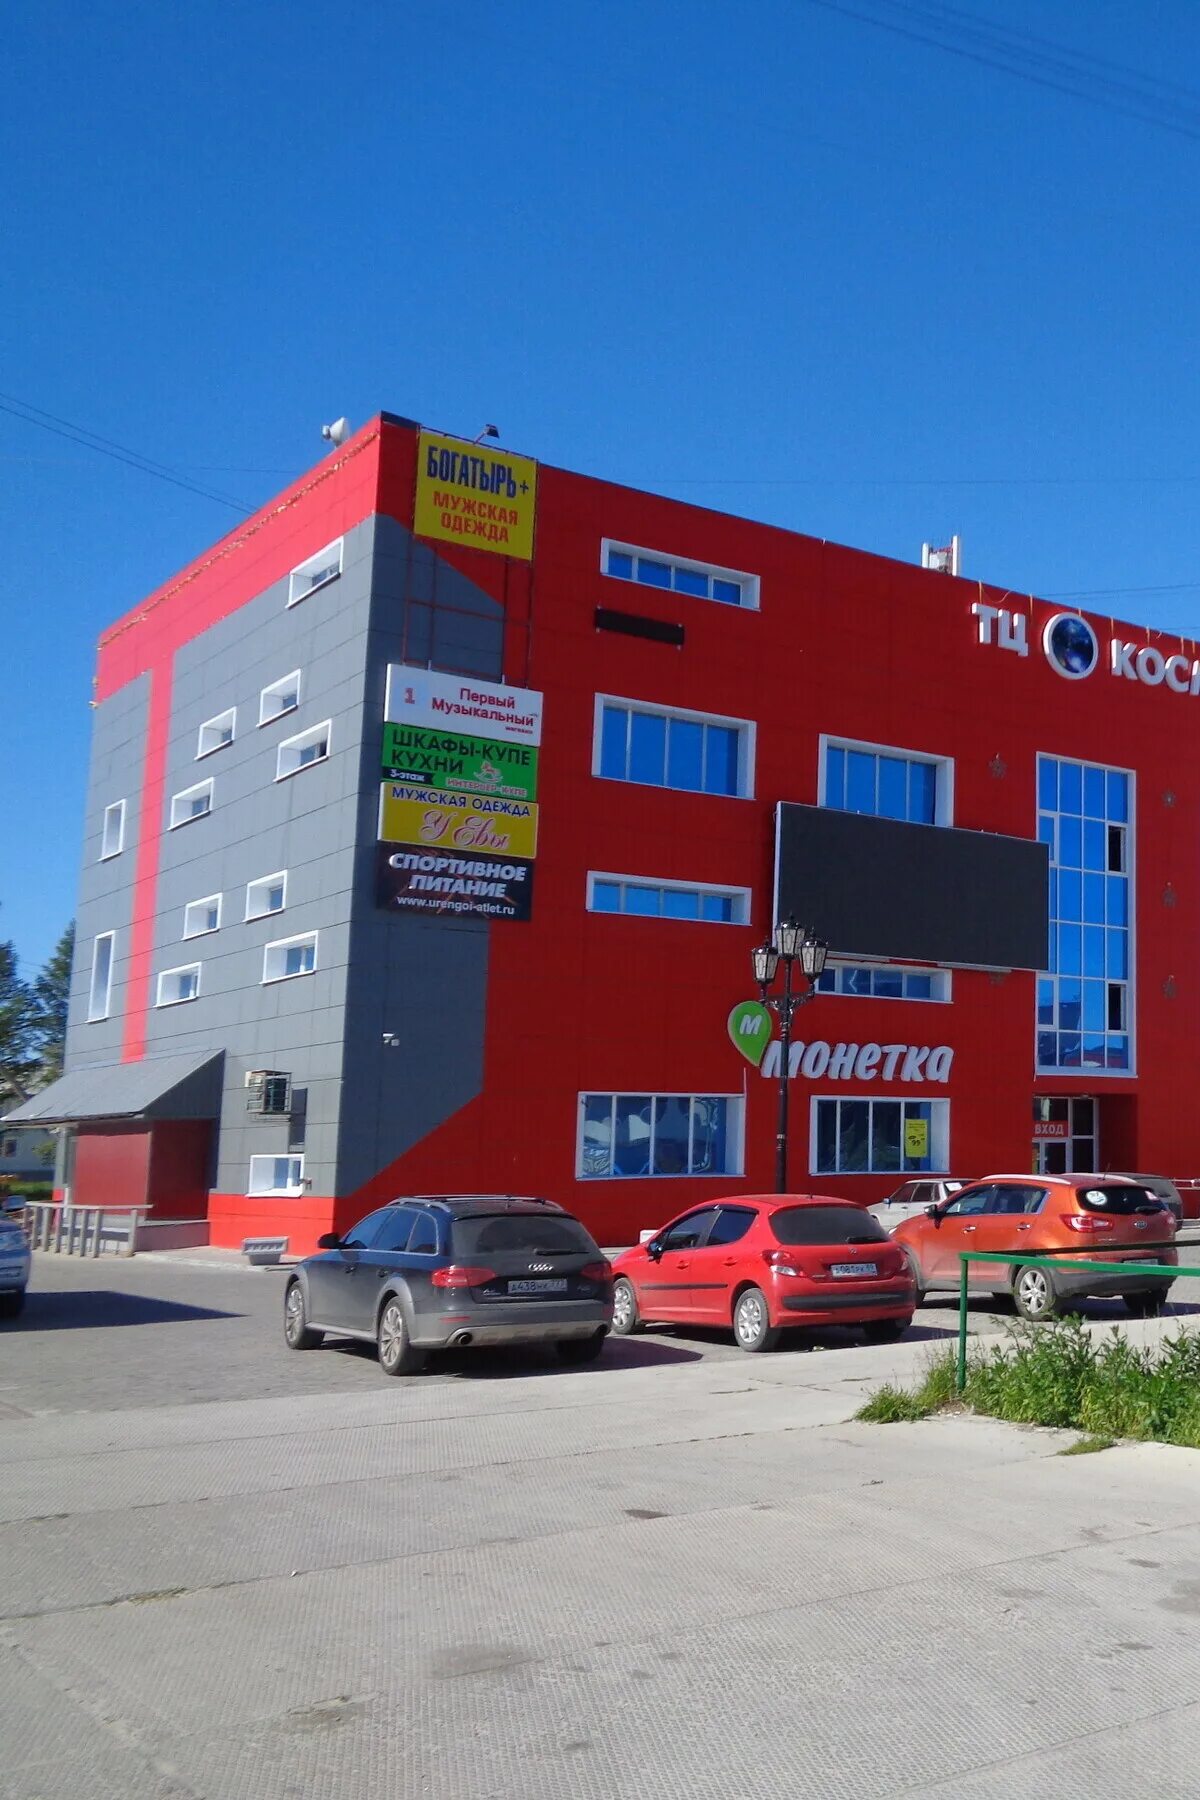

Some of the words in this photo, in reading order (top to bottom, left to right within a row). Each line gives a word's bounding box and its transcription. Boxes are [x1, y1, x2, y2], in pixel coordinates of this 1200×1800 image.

[433, 491, 518, 526] МУЖСКАЯ
[441, 512, 509, 543] ОДЕЖДА
[971, 602, 1028, 657] ТЦ
[432, 697, 534, 726] Музыкальный
[460, 688, 515, 709] Первый
[391, 749, 463, 774] КУХНИ
[392, 729, 531, 766] ШКАФЫ-КУПЕ
[392, 786, 467, 808] МУЖСКАЯ
[472, 798, 530, 817] ОДЕЖДА
[388, 852, 527, 881] СПОРТИВНОЕ
[408, 874, 507, 898] ПИТАНИЕ
[397, 896, 515, 915] www.urengoi-atlet.ru
[1034, 1124, 1064, 1135] ВХОД
